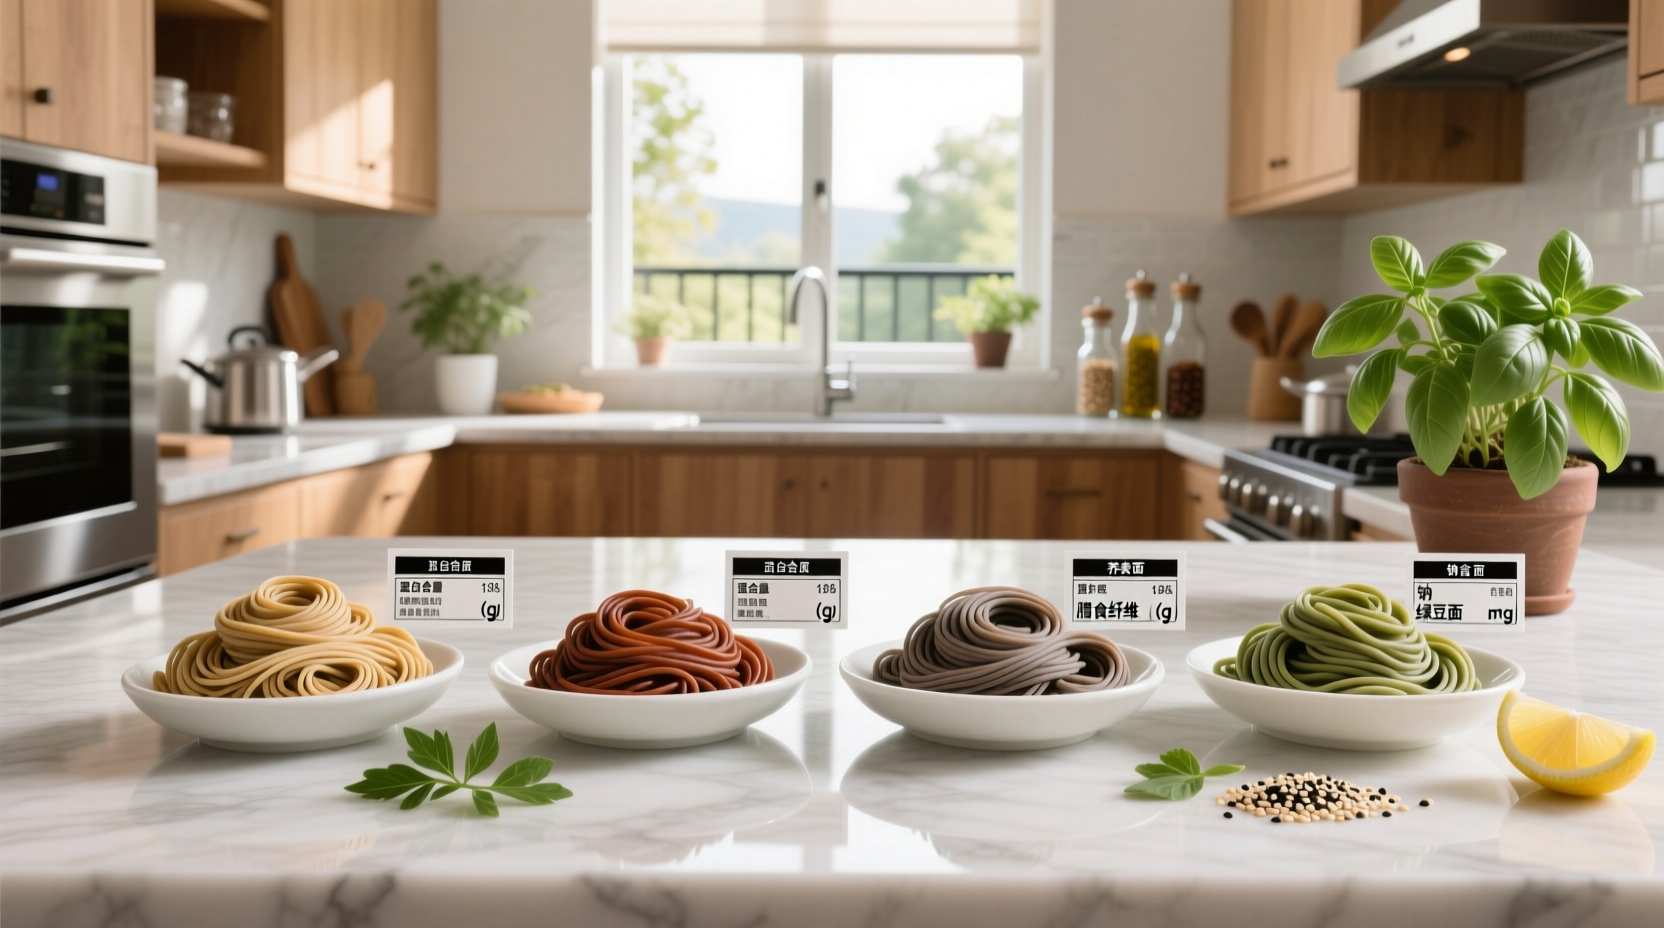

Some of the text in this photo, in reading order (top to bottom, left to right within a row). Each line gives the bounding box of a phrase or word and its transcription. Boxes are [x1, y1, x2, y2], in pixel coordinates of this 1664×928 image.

[816, 602, 837, 623] (g)
[1415, 603, 1464, 621] 绿豆面
[1488, 608, 1514, 625] mg
